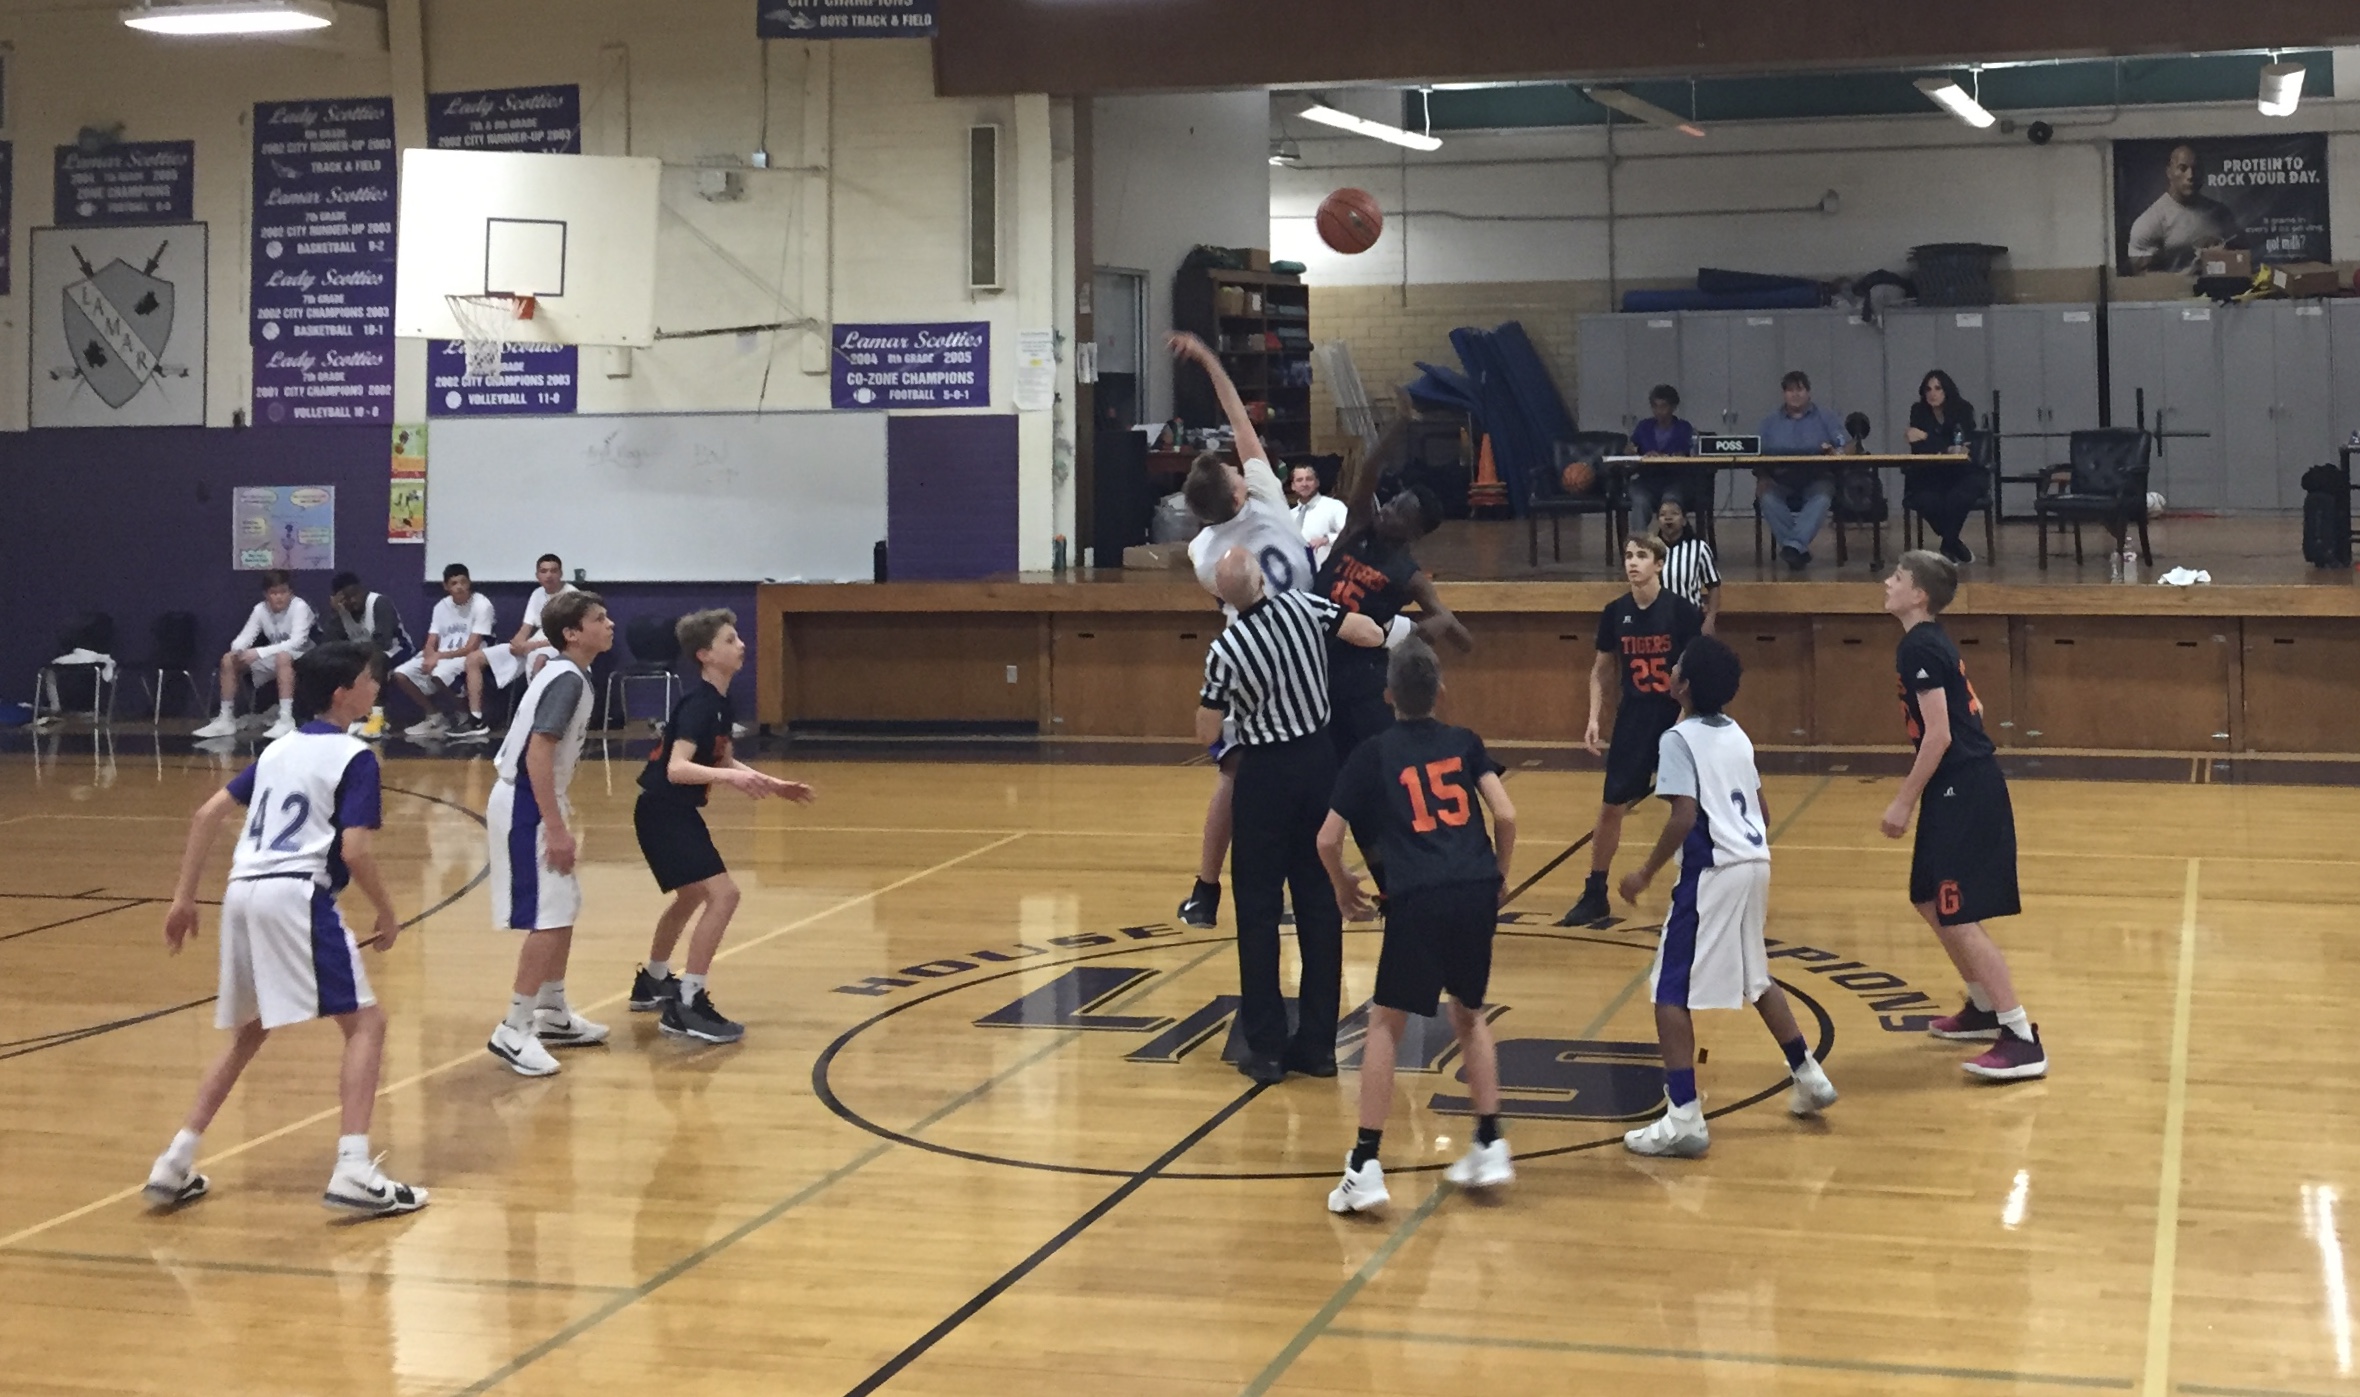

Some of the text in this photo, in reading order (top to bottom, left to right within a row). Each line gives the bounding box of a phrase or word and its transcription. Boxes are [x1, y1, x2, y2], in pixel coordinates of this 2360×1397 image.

[820, 13, 933, 27] BOYS TRACK & FIELD
[464, 134, 484, 146] CITY
[311, 160, 343, 173] TRACK
[355, 159, 382, 172] FIELD
[2223, 156, 2304, 172] PROTEIN TO
[2207, 169, 2320, 187] ROCK YOUR DAY.
[286, 225, 307, 237] CITY
[297, 241, 357, 254] BASKETBALL
[265, 268, 383, 292] Lady Scotties
[283, 308, 304, 319] CITY
[306, 306, 364, 319] CHAMPIONS
[81, 285, 149, 371] LAMAR
[294, 325, 353, 336] BASKETBALL
[840, 330, 983, 349] Lamar Scotties
[265, 349, 383, 372] Lady Scotties
[849, 351, 972, 365] 2004 8th GRADE 2005
[461, 375, 483, 388] CITY
[485, 374, 544, 387] CHAMPIONS
[546, 374, 571, 386] 2003
[847, 371, 975, 385] CO-ZONE CHAMPIONS
[283, 386, 304, 397] CITY
[306, 384, 364, 397] CHAMPIONS
[889, 389, 935, 400] FOOTBALL
[468, 392, 528, 405] VOLLEYBALL
[294, 406, 351, 418] VOLLEYBALL
[1716, 440, 1744, 451] POSS.
[1621, 634, 1672, 655] TIGERS
[1630, 658, 1671, 693] 25
[1399, 756, 1471, 833] 15
[249, 787, 310, 852] 42
[1936, 878, 1964, 916] G
[831, 923, 1184, 997] HOUSE
